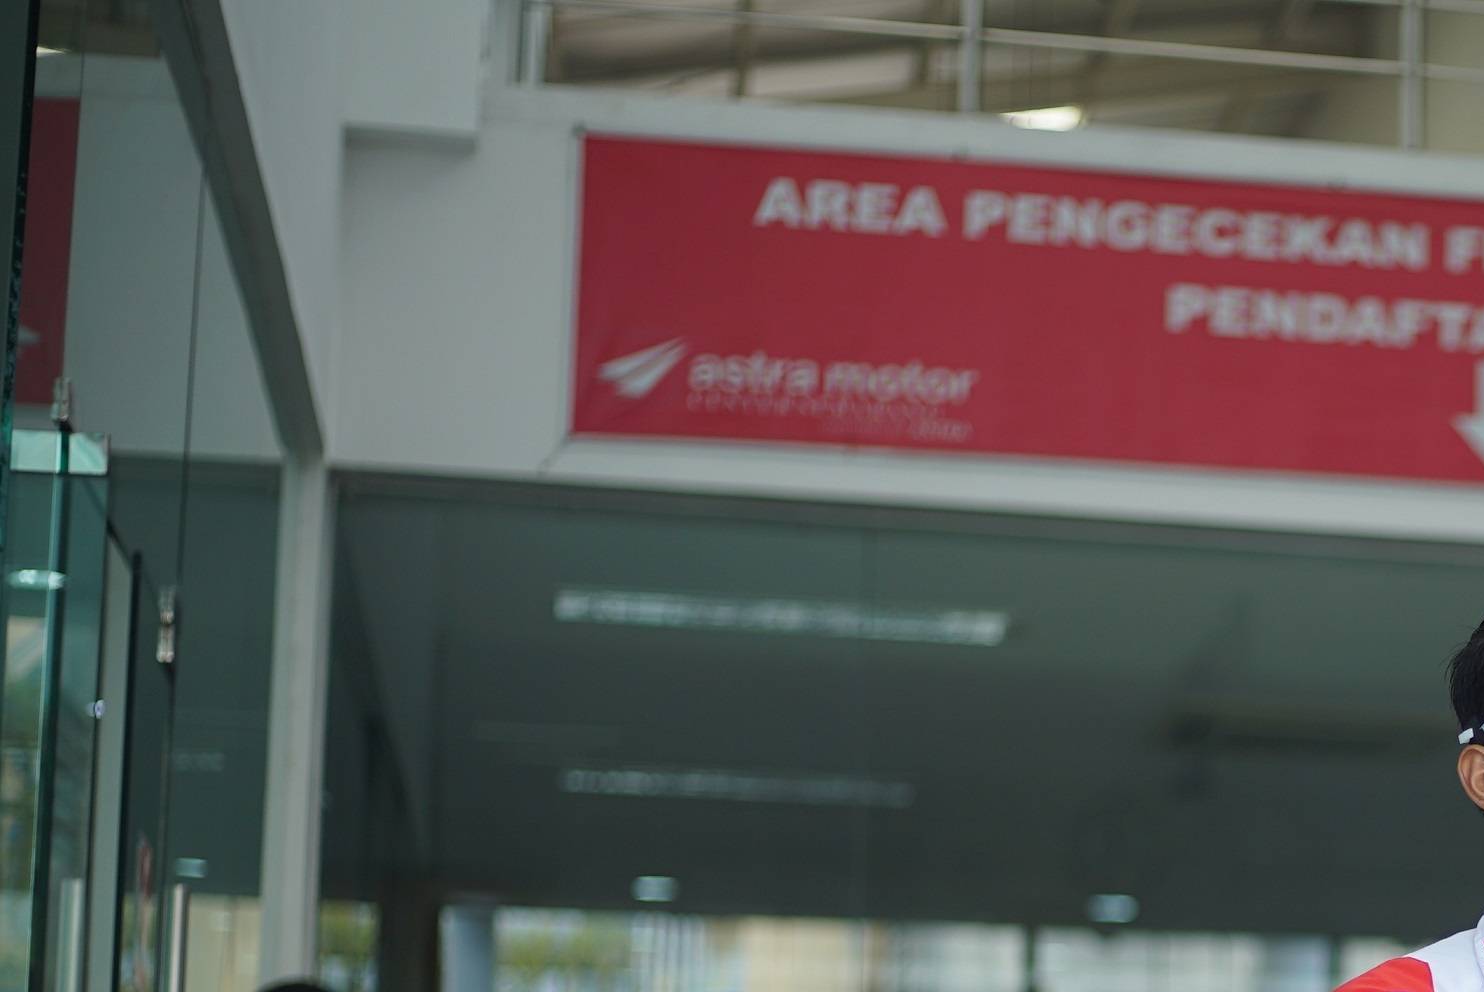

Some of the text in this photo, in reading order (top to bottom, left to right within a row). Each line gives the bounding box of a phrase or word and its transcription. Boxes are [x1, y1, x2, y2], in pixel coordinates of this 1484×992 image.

[754, 177, 948, 238] AREA
[962, 188, 1430, 272] PENGECEKAN
[688, 350, 979, 402] astra motor
